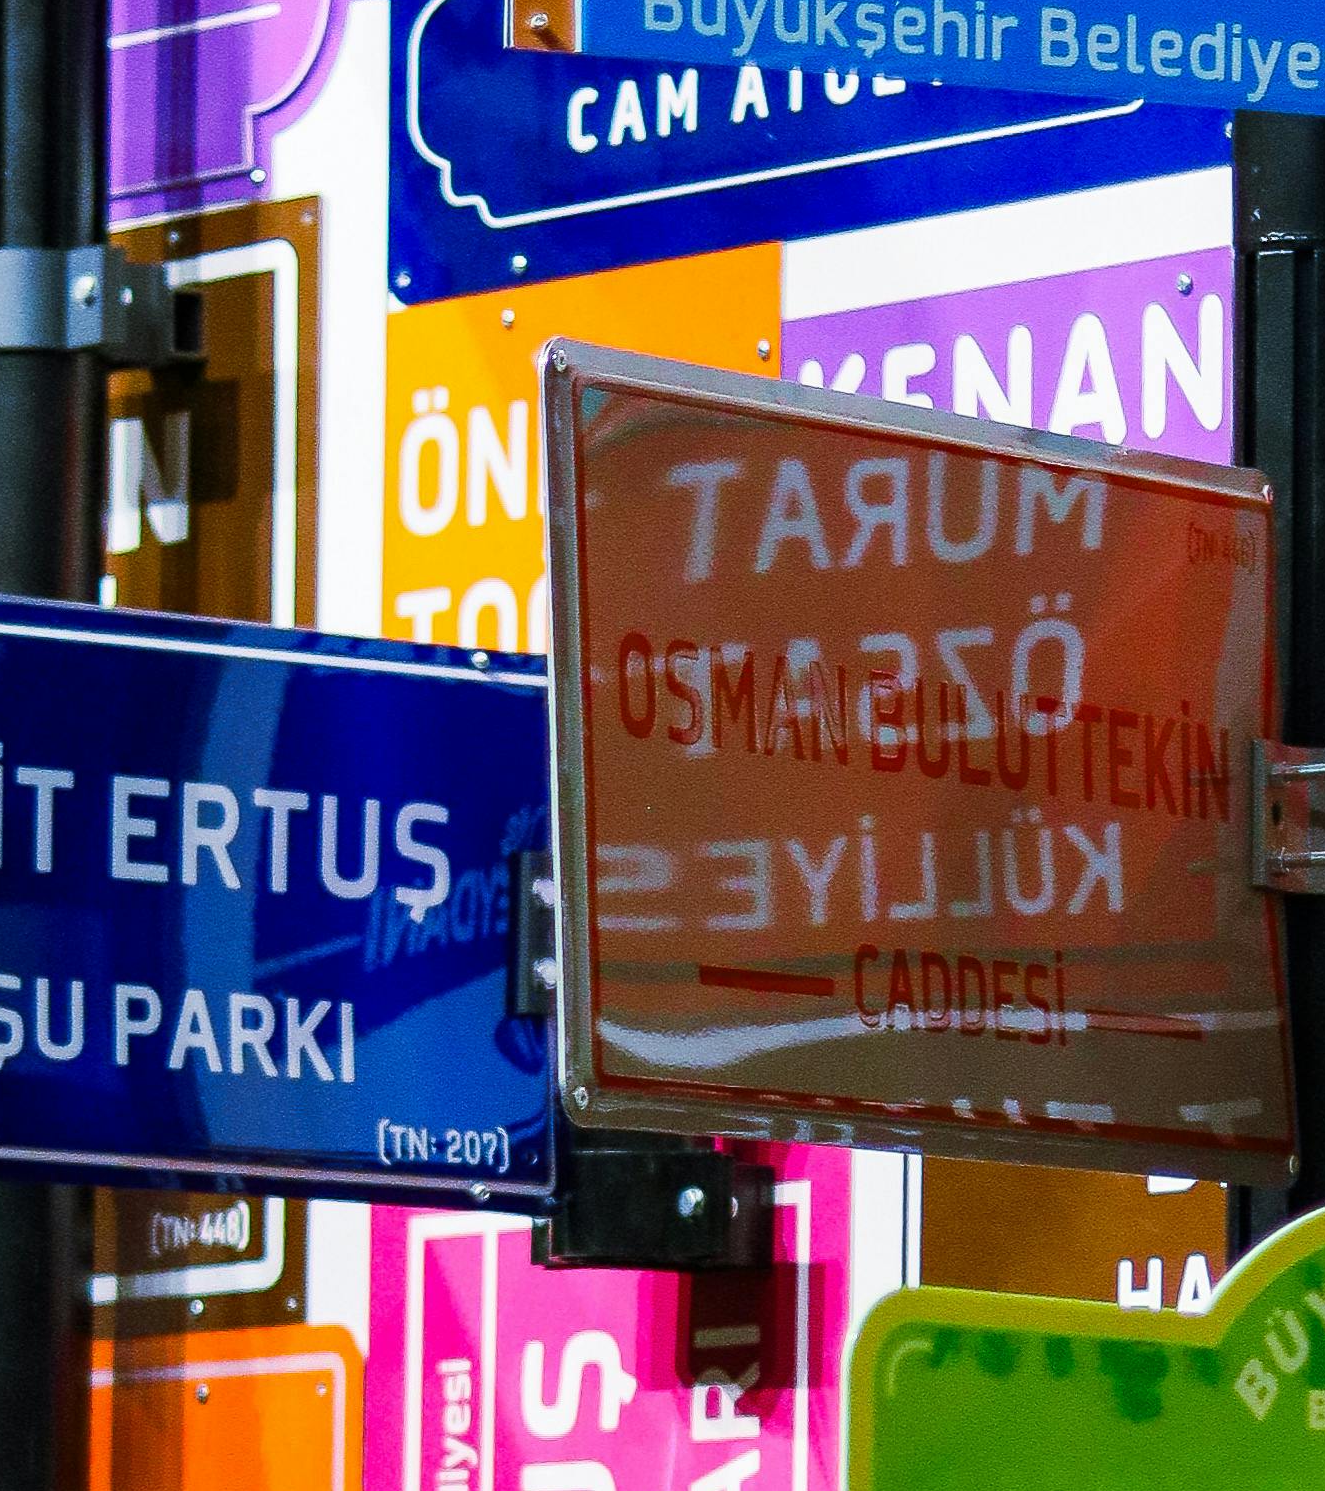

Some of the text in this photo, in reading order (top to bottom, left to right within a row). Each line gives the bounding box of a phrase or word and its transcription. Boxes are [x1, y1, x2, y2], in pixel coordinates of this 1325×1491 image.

[566, 68, 701, 155] CAM
[617, 630, 1231, 822] OSMAN BULUTTEKİN
[110, 775, 454, 924] ERTUŞ
[115, 985, 355, 1084] PARKI
[854, 944, 1067, 1047] CADDESİ
[446, 1129, 511, 1174] 207)
